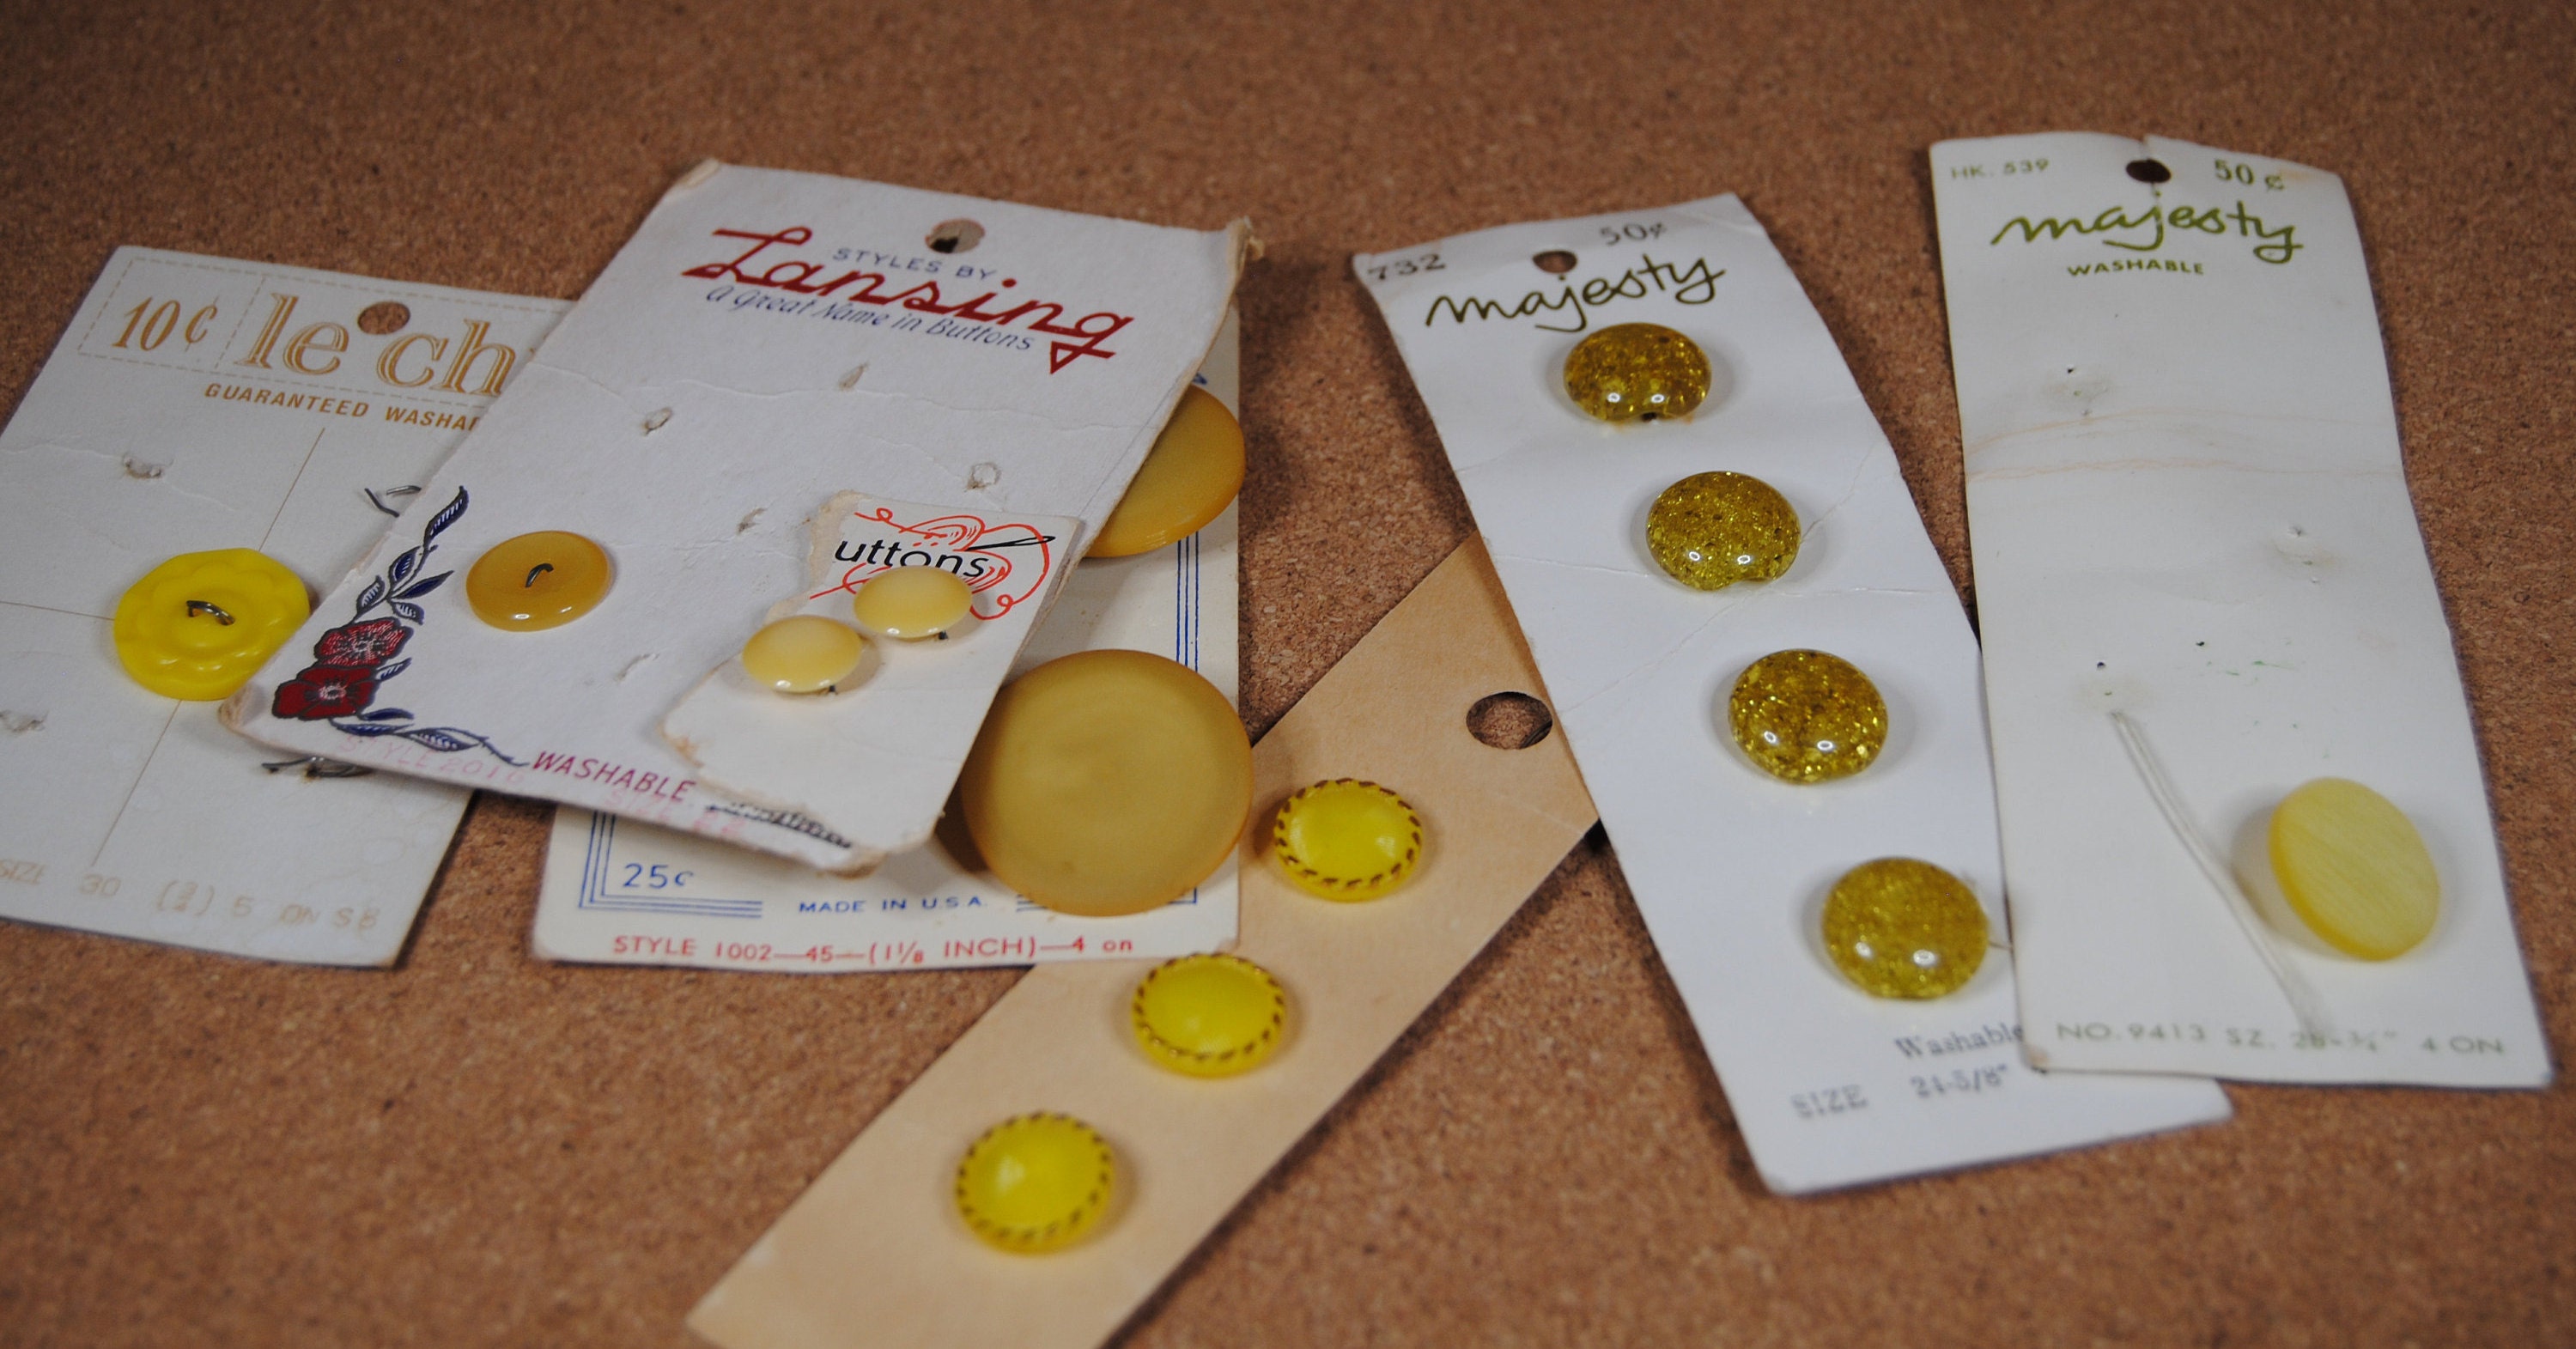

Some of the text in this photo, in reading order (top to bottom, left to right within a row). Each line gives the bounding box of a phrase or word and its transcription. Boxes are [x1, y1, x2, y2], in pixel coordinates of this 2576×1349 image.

[1990, 191, 2305, 264] majesty
[833, 247, 998, 281] STYLES BY
[1368, 253, 1446, 282] 732
[2067, 258, 2205, 276] WASHABLE
[682, 227, 1133, 374] Lansing
[1425, 254, 1726, 333] majesty
[811, 302, 890, 325] Name
[890, 313, 922, 331] in
[926, 317, 1036, 350] Buttons
[234, 293, 536, 398] le ch
[204, 382, 369, 418] GUARANTEED
[834, 538, 990, 579] uttons
[532, 750, 697, 803] WASHABLE
[80, 873, 122, 898] 30
[799, 896, 988, 914] MADE IN U.S.A.
[612, 935, 696, 956] STYLE
[1102, 939, 1133, 954] on
[1893, 1022, 2023, 1059] Washable
[2449, 1035, 2505, 1054] ON
[1789, 1083, 1869, 1118] SIZE
